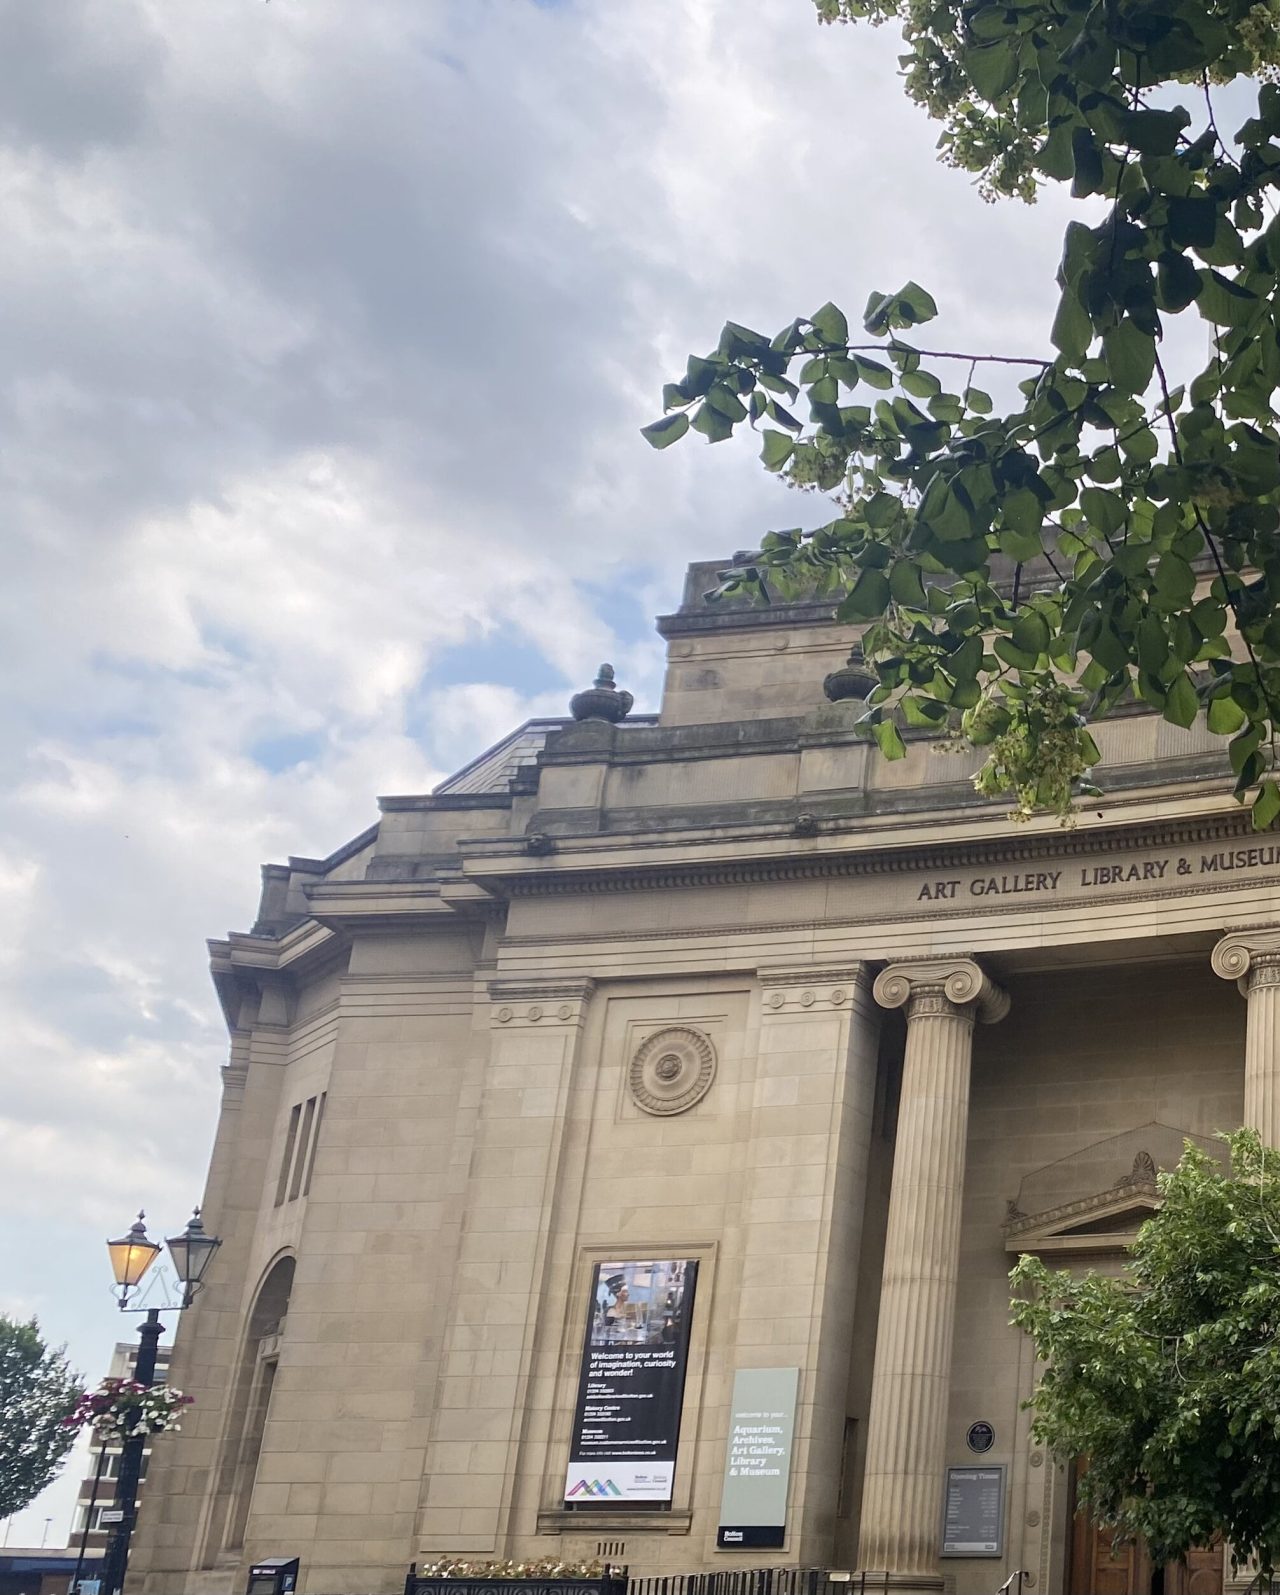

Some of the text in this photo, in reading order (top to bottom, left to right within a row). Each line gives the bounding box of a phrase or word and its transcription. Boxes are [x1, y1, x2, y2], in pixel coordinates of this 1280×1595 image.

[917, 880, 961, 902] ART
[969, 871, 1062, 897] GALLERY
[1080, 859, 1169, 888] LIBRARY
[1176, 857, 1193, 876] &
[591, 1352, 624, 1360] Welcome
[634, 1351, 651, 1360] your
[652, 1350, 674, 1358] world
[598, 1361, 643, 1369] imagination,
[643, 1359, 676, 1368] curiosity
[604, 1369, 633, 1377] wonder!
[734, 1425, 783, 1435] Aquarium,
[733, 1436, 775, 1444] Archives,
[731, 1446, 785, 1455] Art Gallery,
[730, 1457, 766, 1466] Library
[729, 1468, 737, 1476] &
[285, 1576, 293, 1588] P
